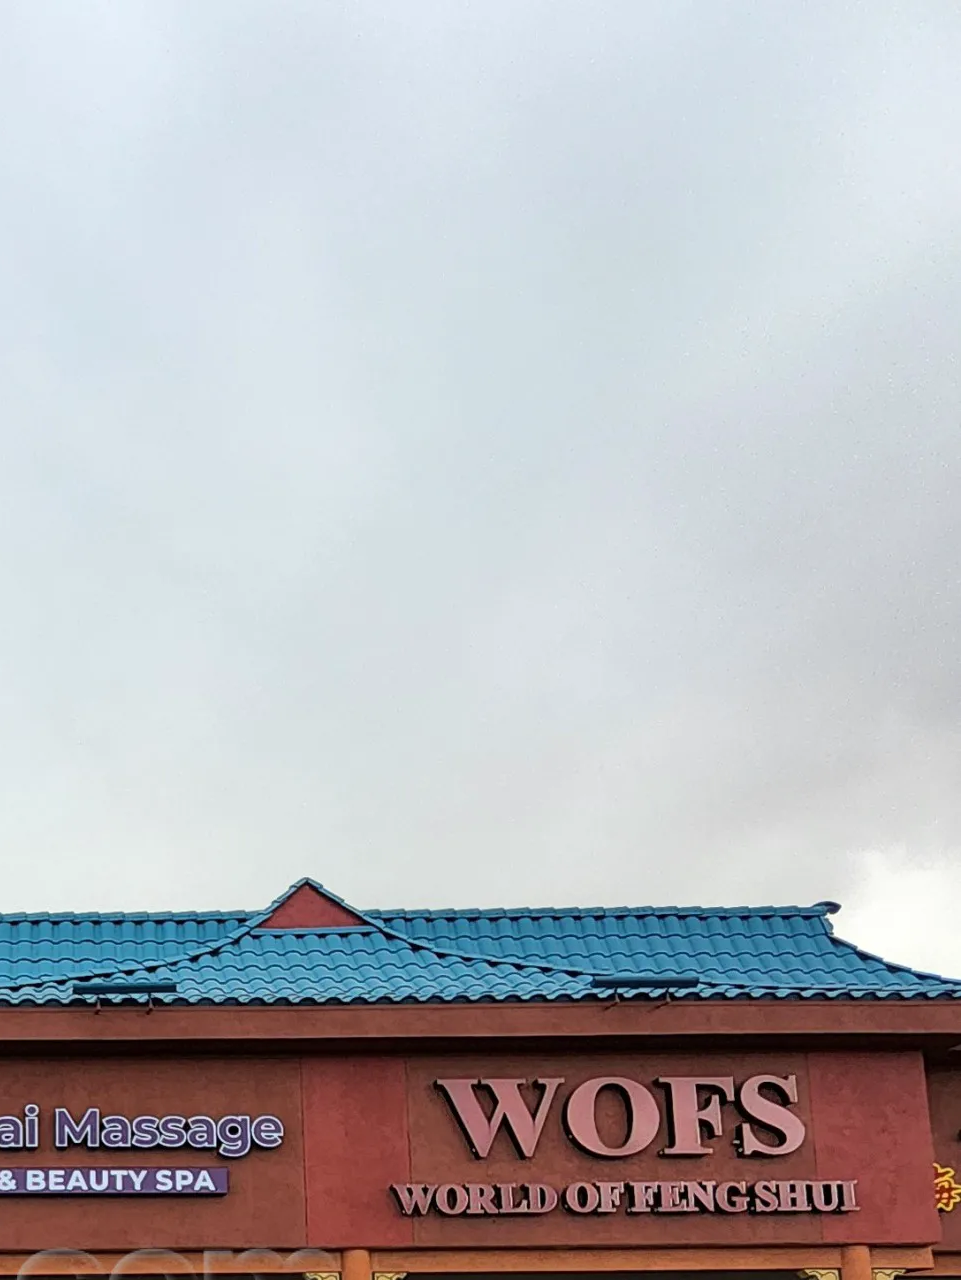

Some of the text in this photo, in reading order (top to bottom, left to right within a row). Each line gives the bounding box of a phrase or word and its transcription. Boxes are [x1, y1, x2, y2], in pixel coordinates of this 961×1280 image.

[54, 1108, 284, 1157] Massage
[437, 1074, 806, 1158] WOFS
[25, 1169, 146, 1191] BEAUTY
[155, 1169, 216, 1191] SPA
[390, 1179, 861, 1215] WORLD OF FENG SHUI
